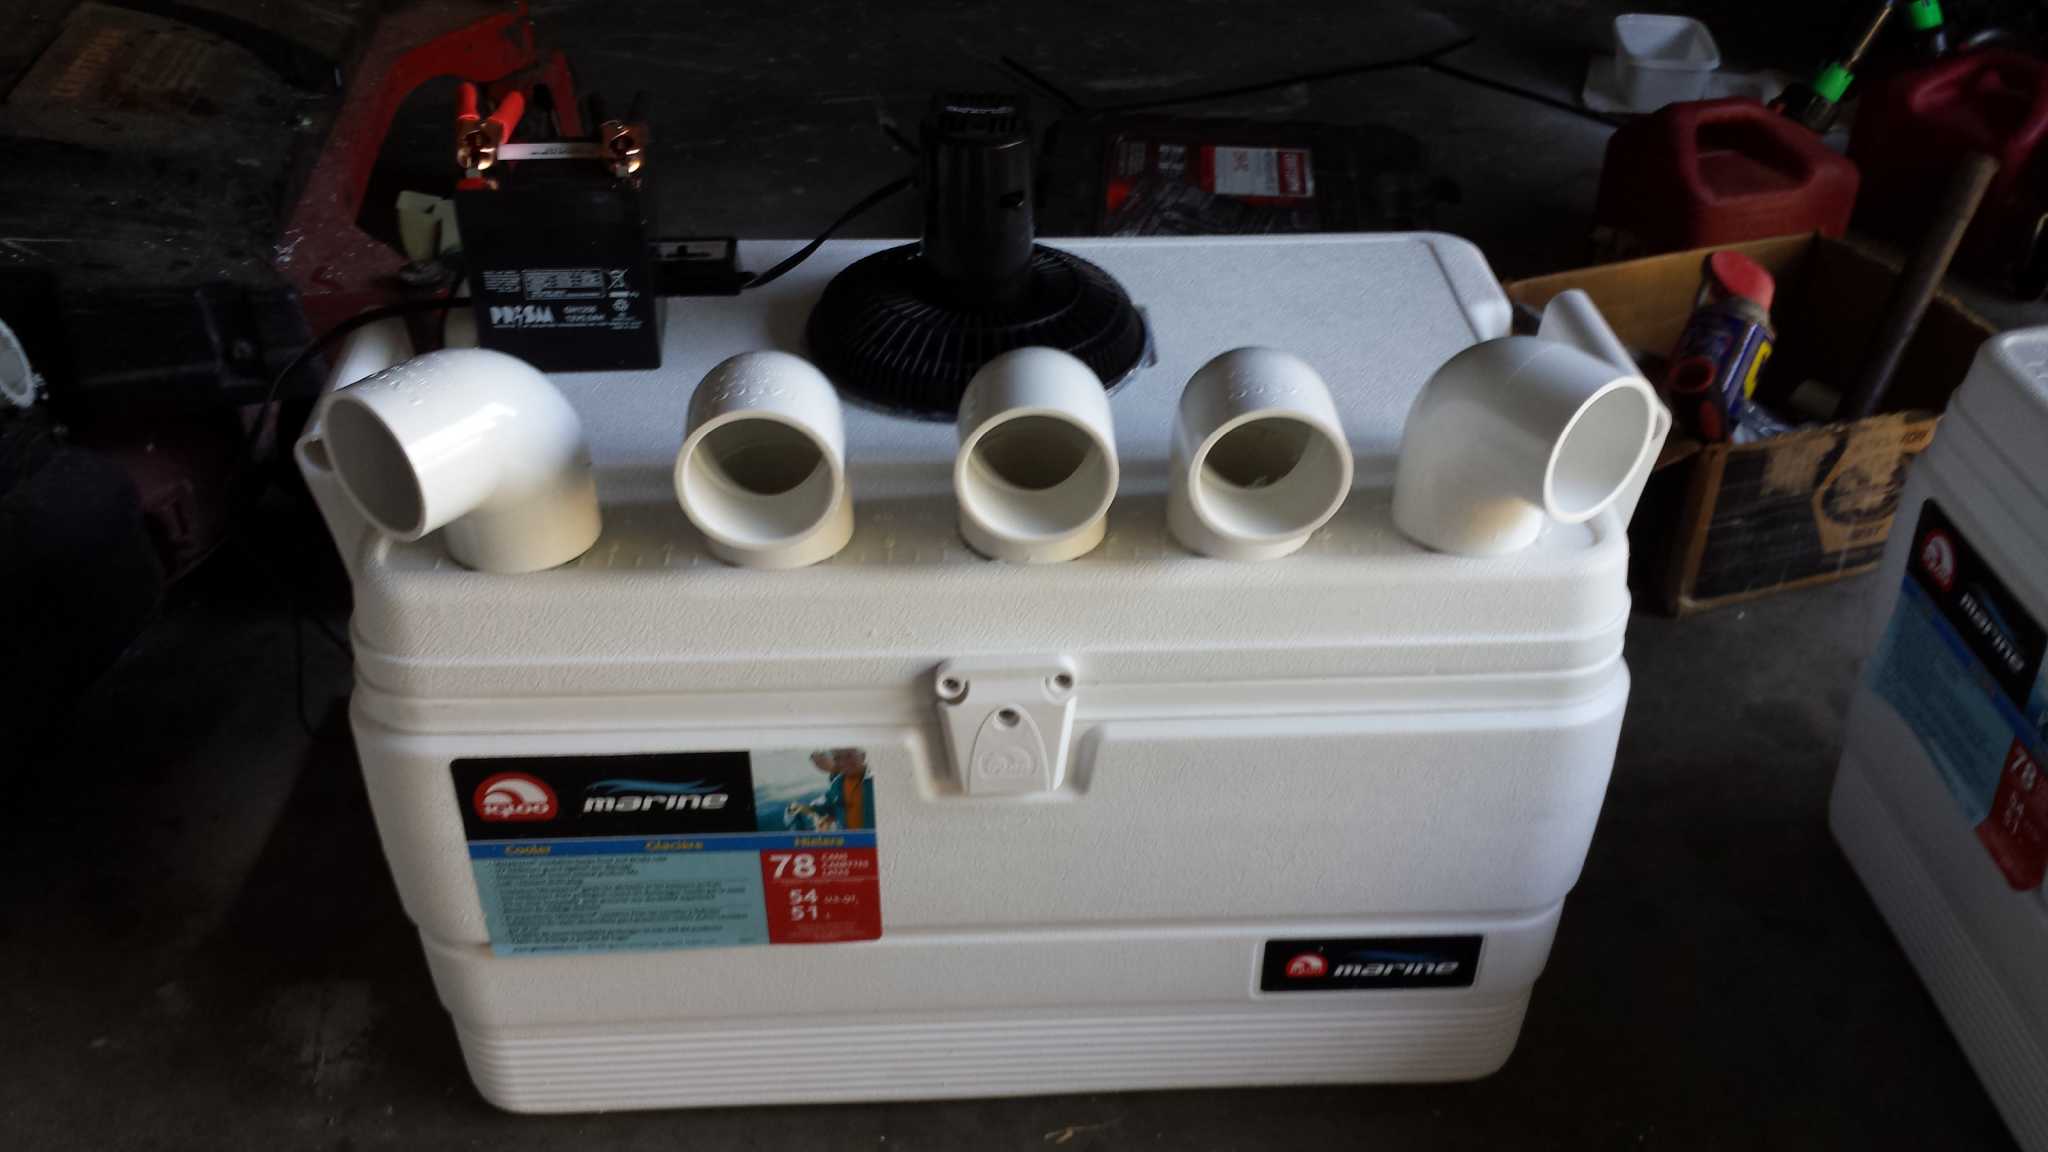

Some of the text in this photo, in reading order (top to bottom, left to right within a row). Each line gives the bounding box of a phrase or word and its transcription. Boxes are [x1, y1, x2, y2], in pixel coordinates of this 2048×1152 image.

[583, 793, 729, 813] marine
[769, 853, 817, 880] 78
[790, 888, 818, 904] 54
[791, 904, 818, 921] 51
[1333, 961, 1460, 977] marine
